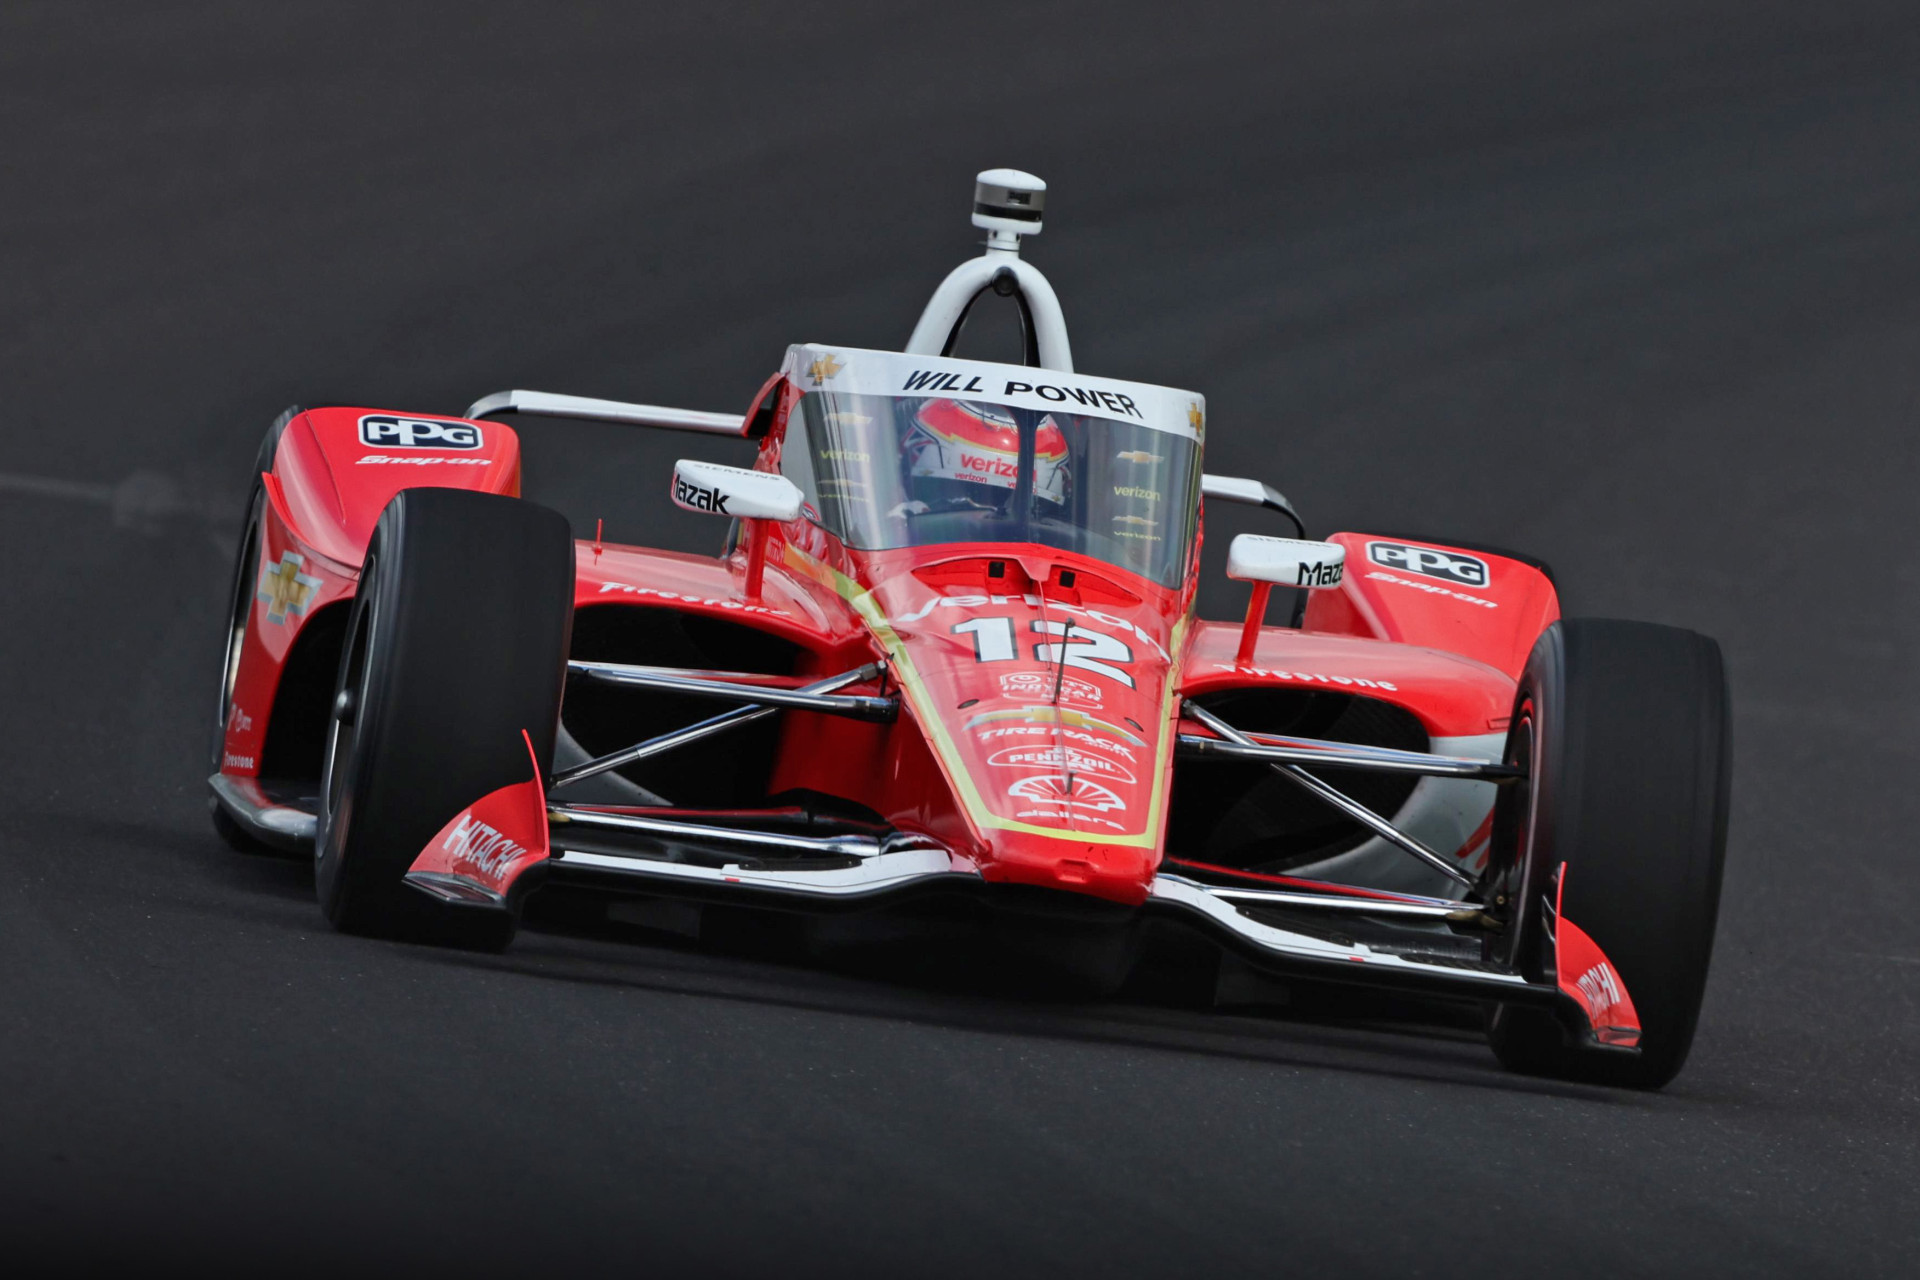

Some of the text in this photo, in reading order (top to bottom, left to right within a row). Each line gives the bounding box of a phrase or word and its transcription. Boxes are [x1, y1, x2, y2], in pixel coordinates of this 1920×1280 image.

[903, 370, 1144, 419] WILL POWER
[367, 420, 475, 446] PPG
[355, 455, 492, 466] Snap-on
[954, 472, 988, 484] verizon
[1113, 486, 1161, 501] verizon
[1374, 546, 1482, 582] PPG
[600, 581, 791, 616] Firestone
[1364, 572, 1498, 609] Snap-on
[896, 594, 1172, 663] verizon
[951, 616, 1137, 691] 12
[979, 727, 1137, 764] TIRE RACK
[1008, 752, 1116, 773] PENNZOIL
[442, 814, 527, 881] HITACHI
